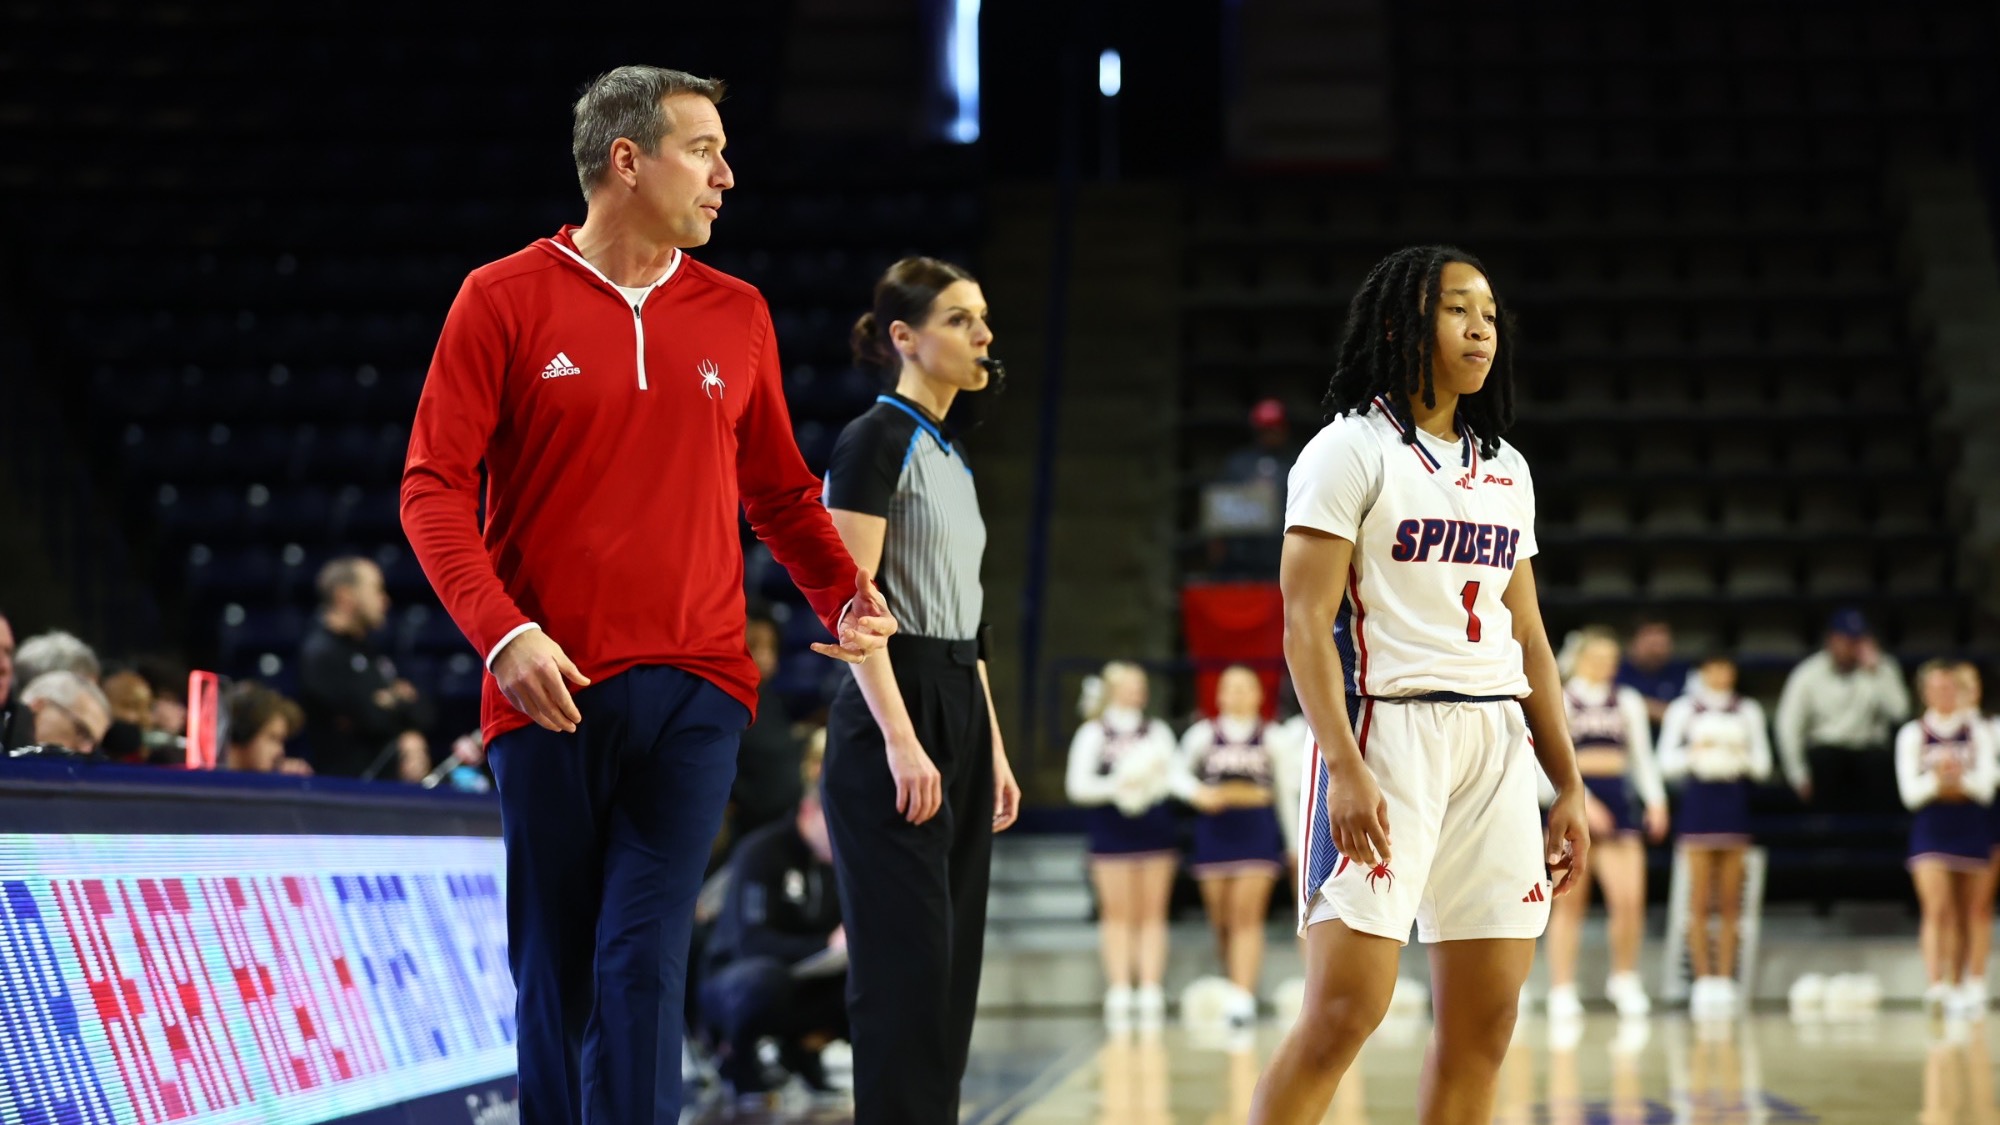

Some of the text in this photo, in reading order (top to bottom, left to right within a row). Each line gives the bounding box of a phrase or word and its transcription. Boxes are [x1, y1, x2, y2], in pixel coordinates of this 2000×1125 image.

[541, 366, 581, 379] adidas
[1391, 518, 1520, 571] SPIDERS
[1459, 580, 1482, 643] 1
[50, 877, 254, 1125] HEART
[198, 875, 389, 1095] HEALTH
